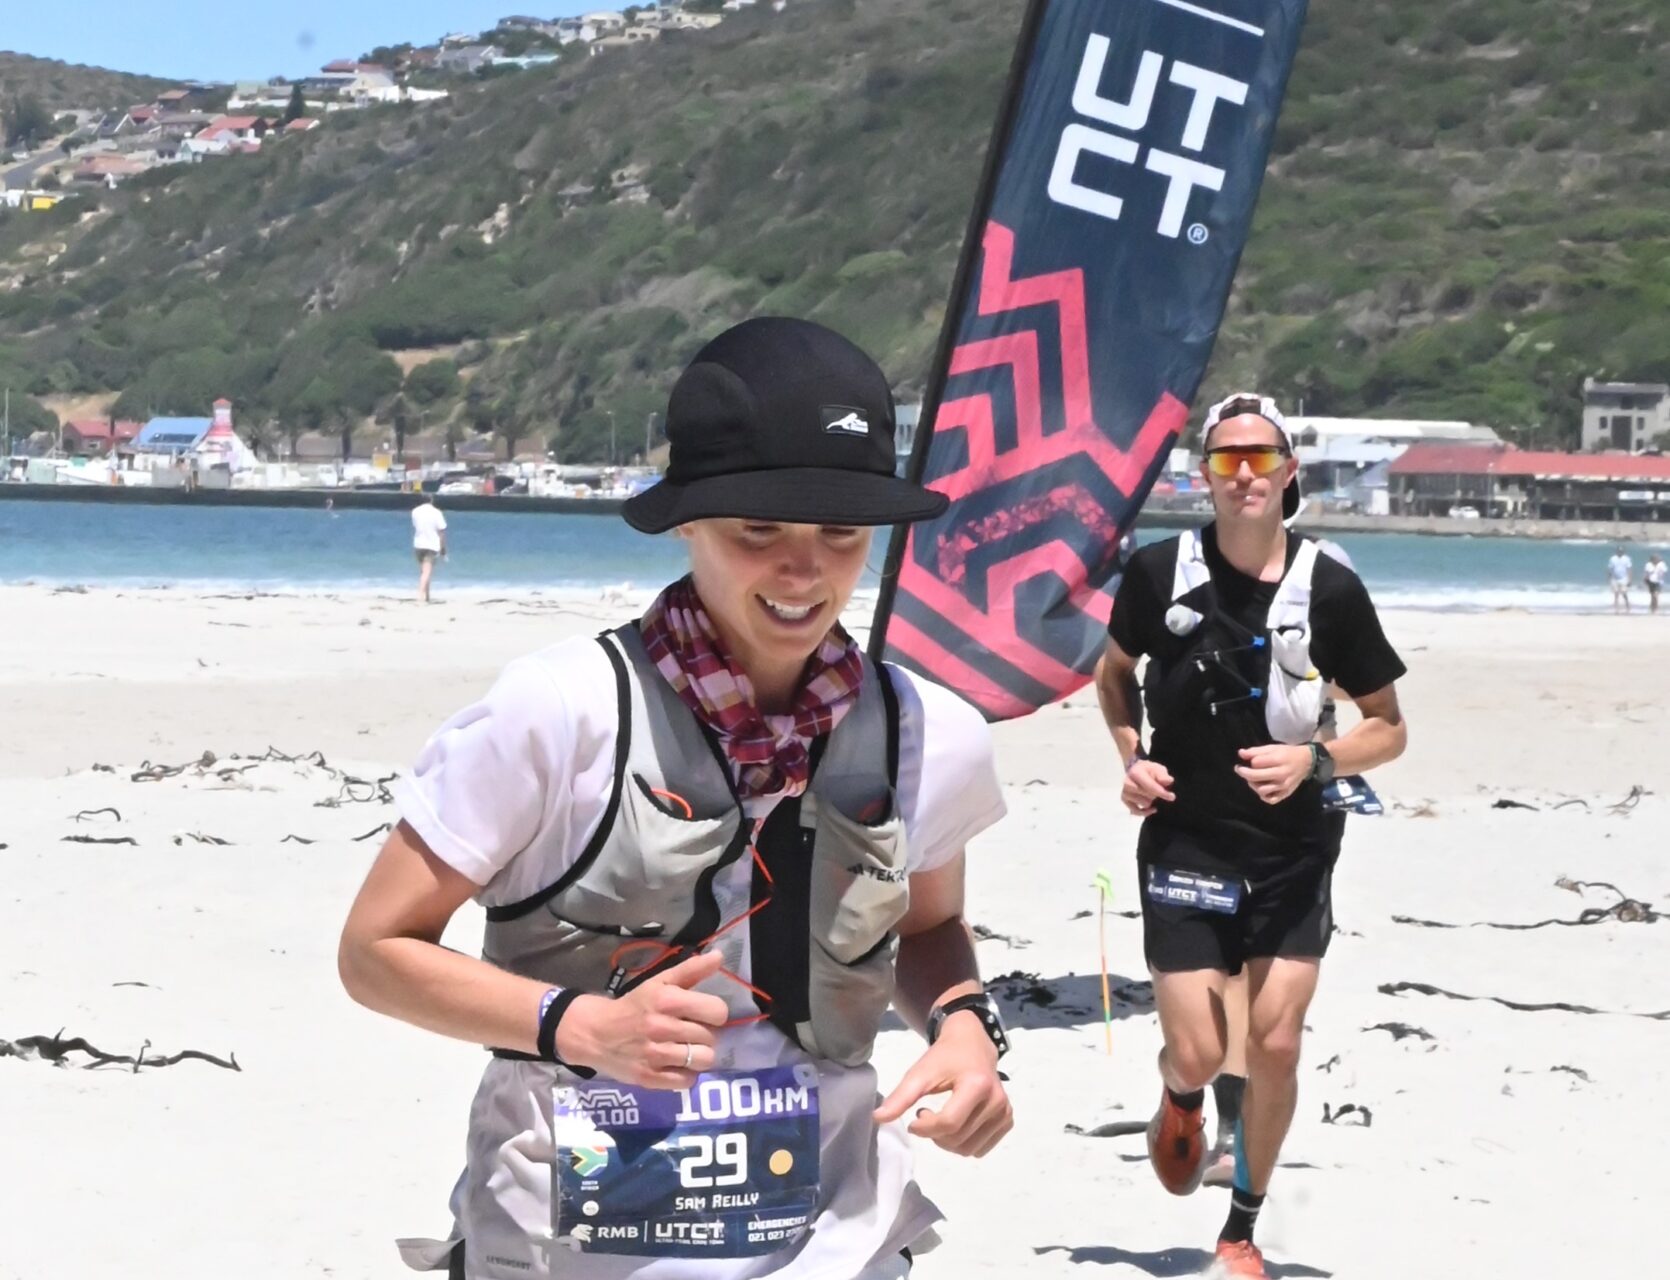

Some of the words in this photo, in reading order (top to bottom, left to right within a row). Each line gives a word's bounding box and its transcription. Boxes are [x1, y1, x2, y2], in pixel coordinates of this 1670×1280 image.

[677, 1132, 748, 1188] 29
[597, 1226, 639, 1238] RMB
[655, 1222, 725, 1239] UTCT
[747, 1232, 766, 1242] 021
